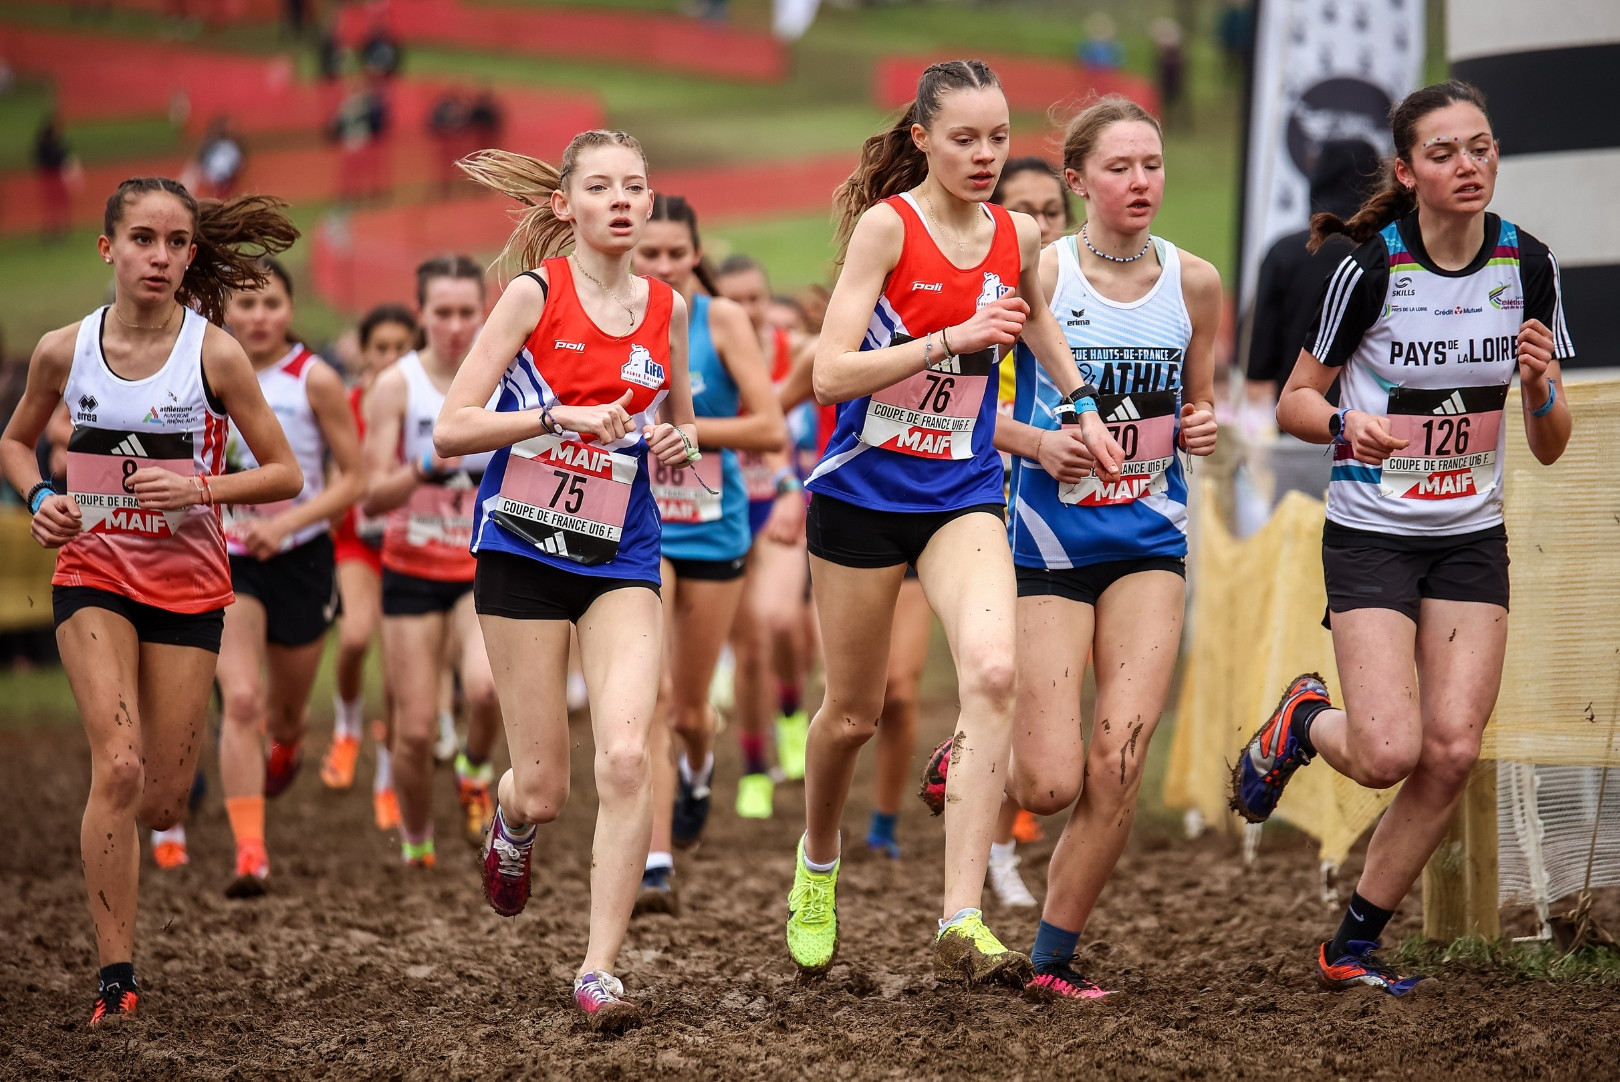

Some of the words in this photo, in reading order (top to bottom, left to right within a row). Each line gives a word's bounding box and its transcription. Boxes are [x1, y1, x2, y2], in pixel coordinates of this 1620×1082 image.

[912, 283, 943, 292] poli
[1067, 318, 1090, 326] erima
[1434, 308, 1453, 316] Crédit
[1463, 306, 1482, 314] Mutuel
[555, 341, 586, 351] poli
[1072, 349, 1088, 360] GUE
[1090, 348, 1169, 361] HAUTS-DE-FRANCE
[1390, 341, 1447, 366] PAYS
[1448, 340, 1459, 350] DE
[1458, 353, 1469, 364] LA
[1469, 335, 1519, 363] LOIRE
[918, 374, 955, 414] 76
[874, 404, 905, 421] COUPE
[906, 411, 919, 424] DE
[920, 416, 950, 430] FRANCE
[951, 419, 964, 430] U16
[963, 420, 970, 430] F.
[896, 431, 952, 454] MAIF
[1422, 417, 1471, 456] 126
[549, 445, 614, 473] MAIF
[1120, 463, 1146, 476] ANCE
[1148, 460, 1161, 473] U16
[1389, 458, 1421, 471] COUPE
[1424, 460, 1435, 471] DE
[1438, 458, 1467, 470] FRANCE
[1469, 454, 1482, 466] U16
[1483, 453, 1489, 464] F.
[122, 459, 138, 494] 8
[1418, 473, 1474, 496] MAIF
[548, 470, 588, 513] 75
[1095, 479, 1152, 499] MAIF
[74, 494, 105, 506] COUPE
[107, 496, 120, 507] DE
[105, 512, 167, 534] MAIF
[503, 500, 536, 519] COUPE
[536, 510, 550, 523] DE
[551, 514, 587, 532] FRANCE
[588, 524, 606, 537] U16
[606, 528, 614, 540] F.
